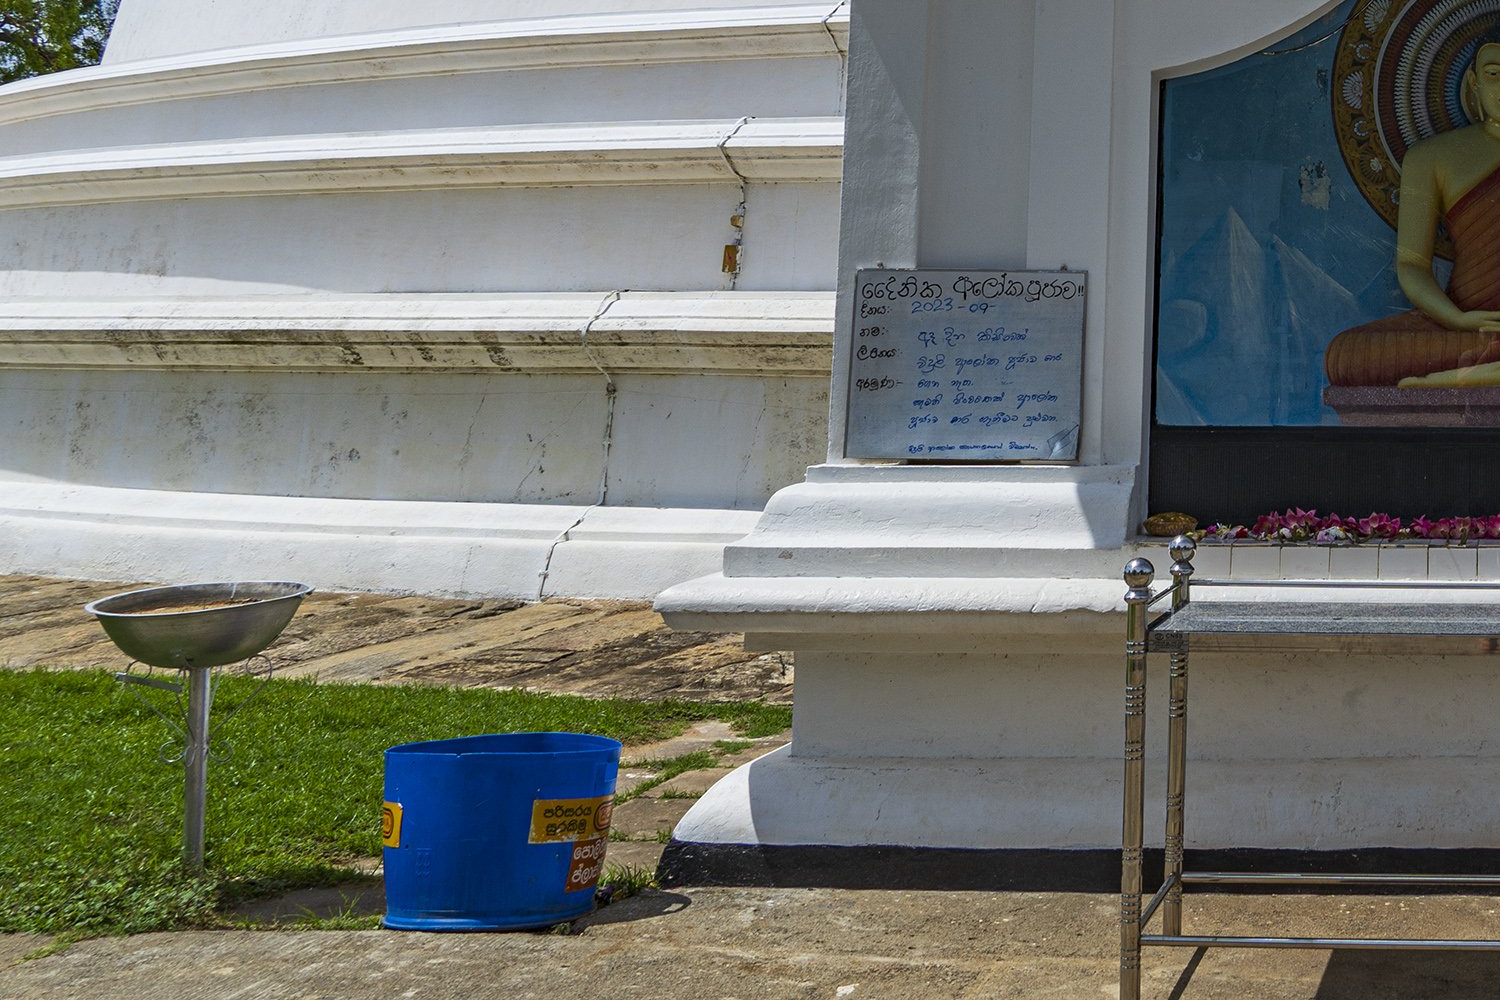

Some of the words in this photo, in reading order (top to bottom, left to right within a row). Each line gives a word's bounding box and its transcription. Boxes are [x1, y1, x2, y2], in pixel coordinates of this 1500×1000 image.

[862, 276, 942, 299] දෛනික
[953, 273, 1024, 301] ආලෝක
[544, 805, 592, 818] පරිසරය
